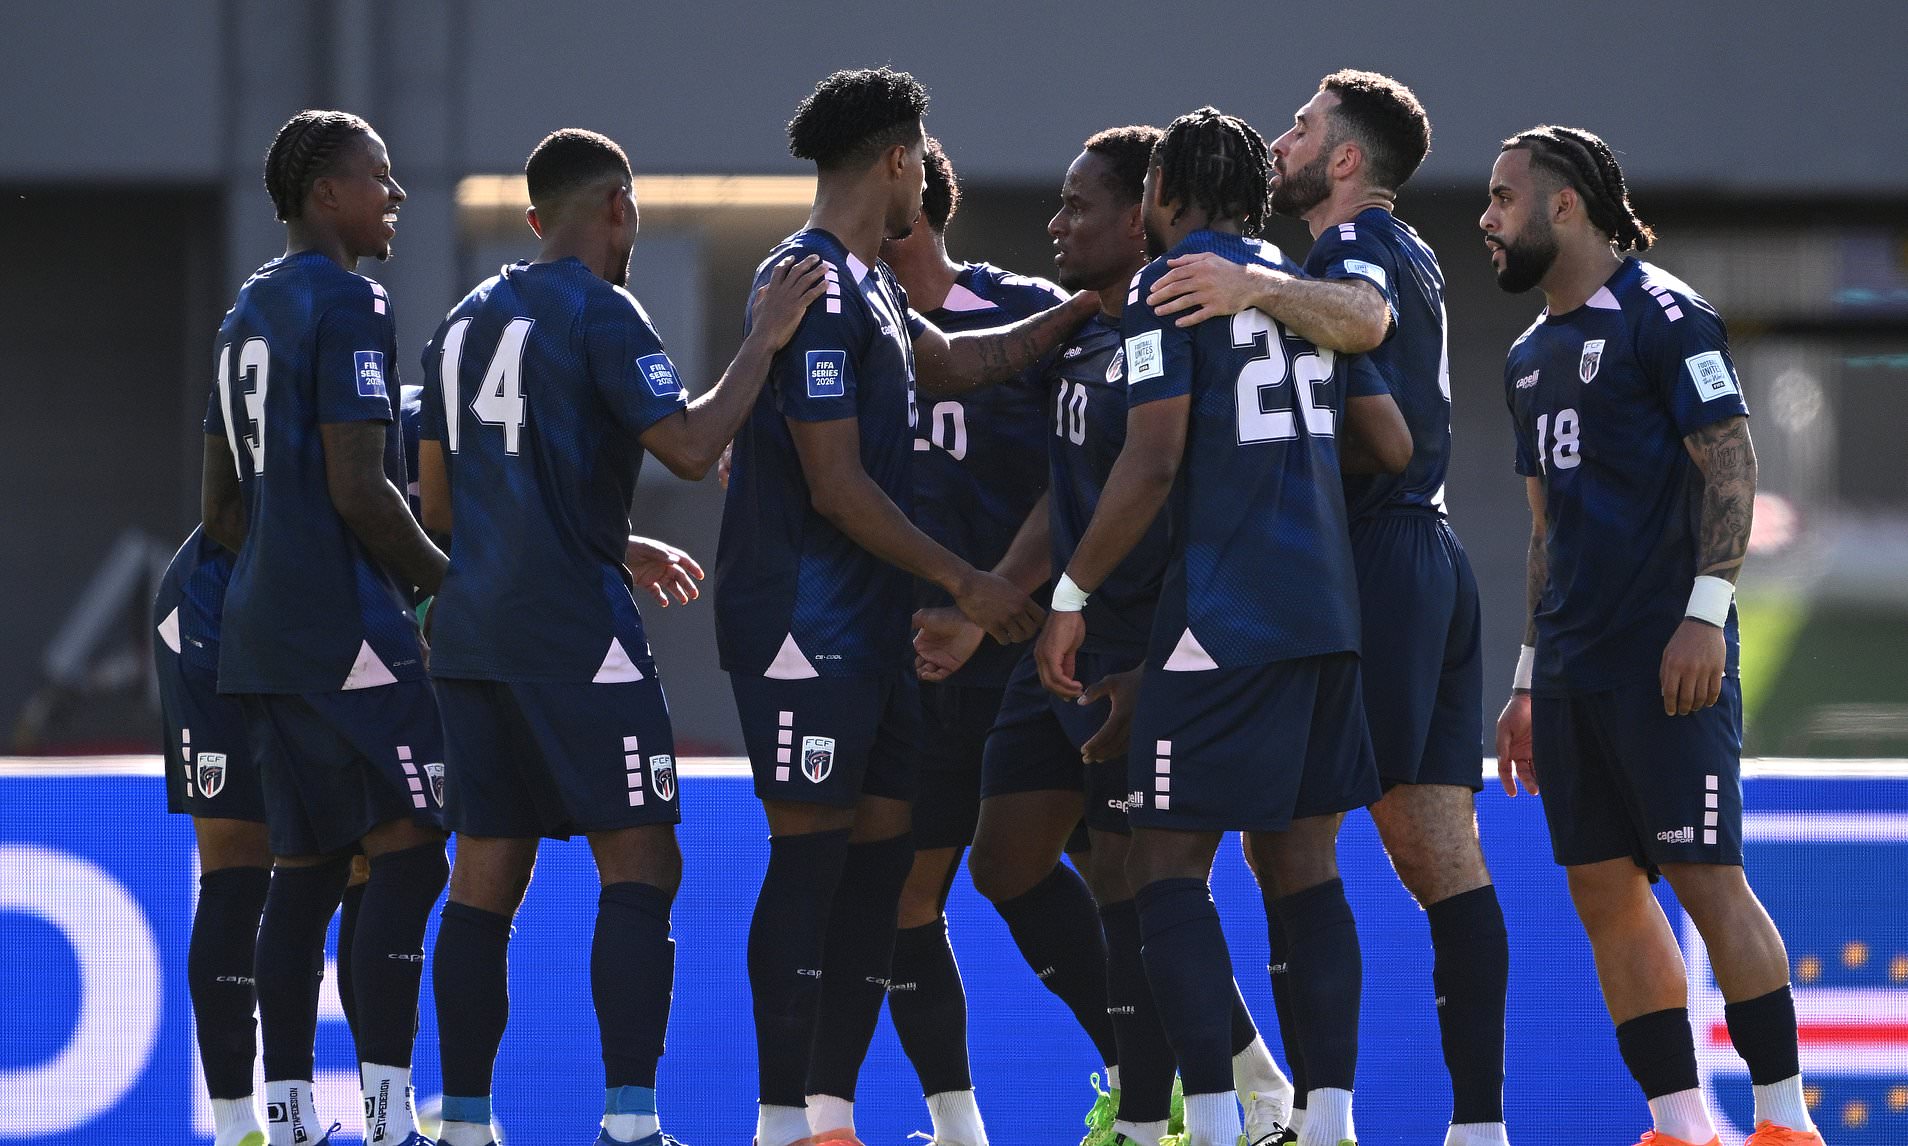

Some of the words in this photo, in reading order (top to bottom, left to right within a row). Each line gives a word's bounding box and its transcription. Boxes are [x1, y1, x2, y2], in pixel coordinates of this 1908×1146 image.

[440, 317, 536, 456] 14
[812, 370, 838, 378] SERIES
[816, 361, 834, 369] FIFA
[1230, 307, 1337, 446] 22
[218, 336, 270, 481] 13
[1056, 377, 1088, 446] 10
[1537, 408, 1581, 475] 18
[200, 755, 224, 763] FCF
[806, 738, 832, 747] FCF
[1657, 826, 1694, 843] capelli
[377, 1079, 390, 1124] TAPEDESIGN
